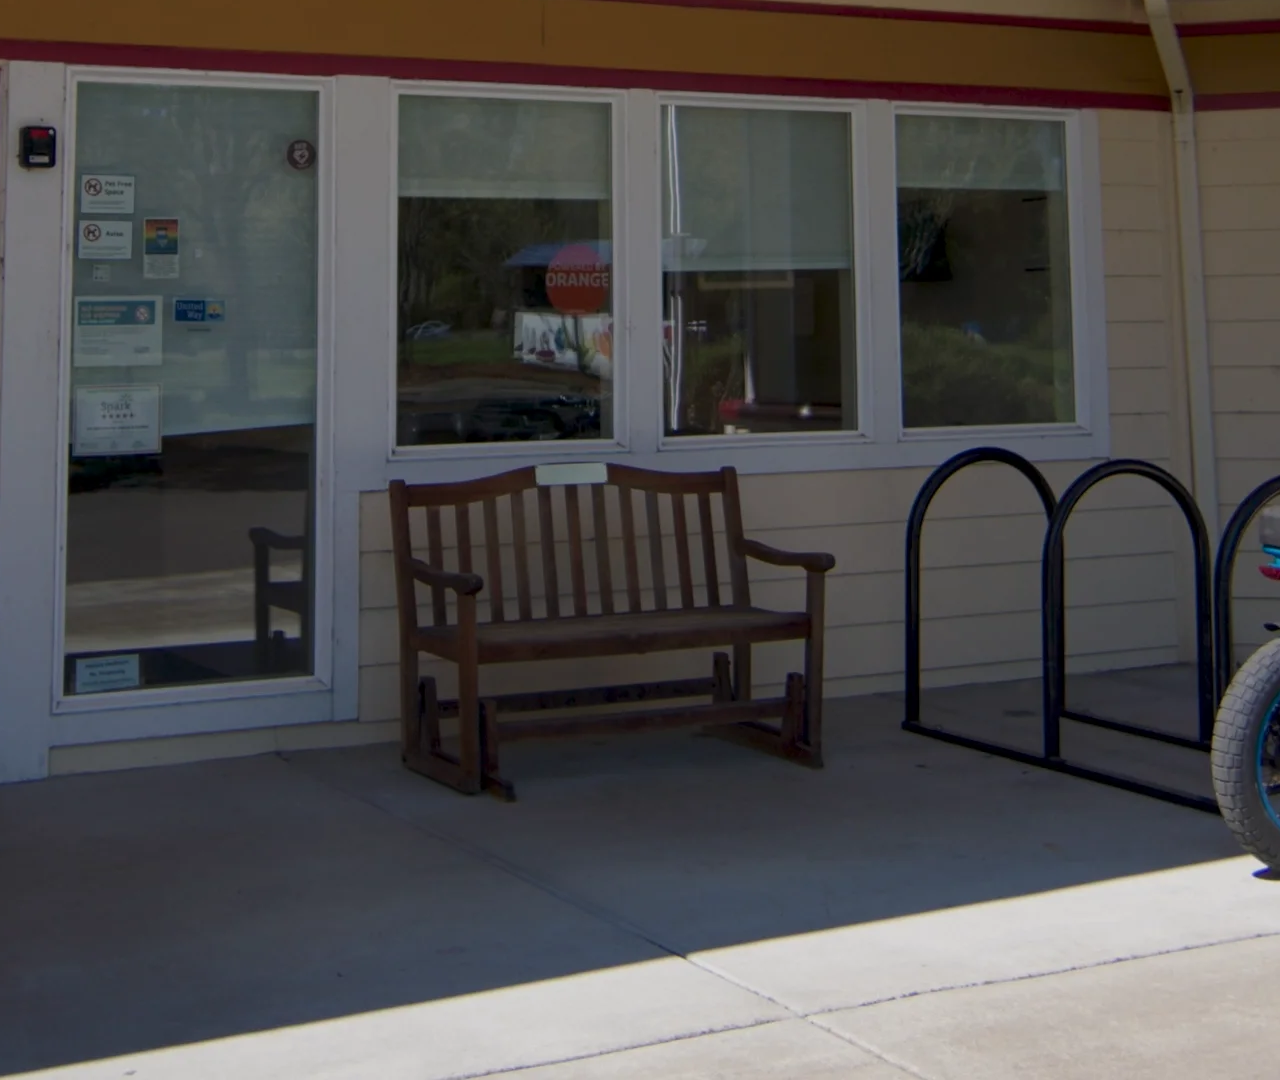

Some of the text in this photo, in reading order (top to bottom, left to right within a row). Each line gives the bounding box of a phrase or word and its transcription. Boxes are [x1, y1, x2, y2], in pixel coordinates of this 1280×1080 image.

[545, 272, 609, 287] ORANGE
[177, 301, 204, 311] United
[187, 311, 203, 320] Way
[100, 401, 131, 413] Spark
